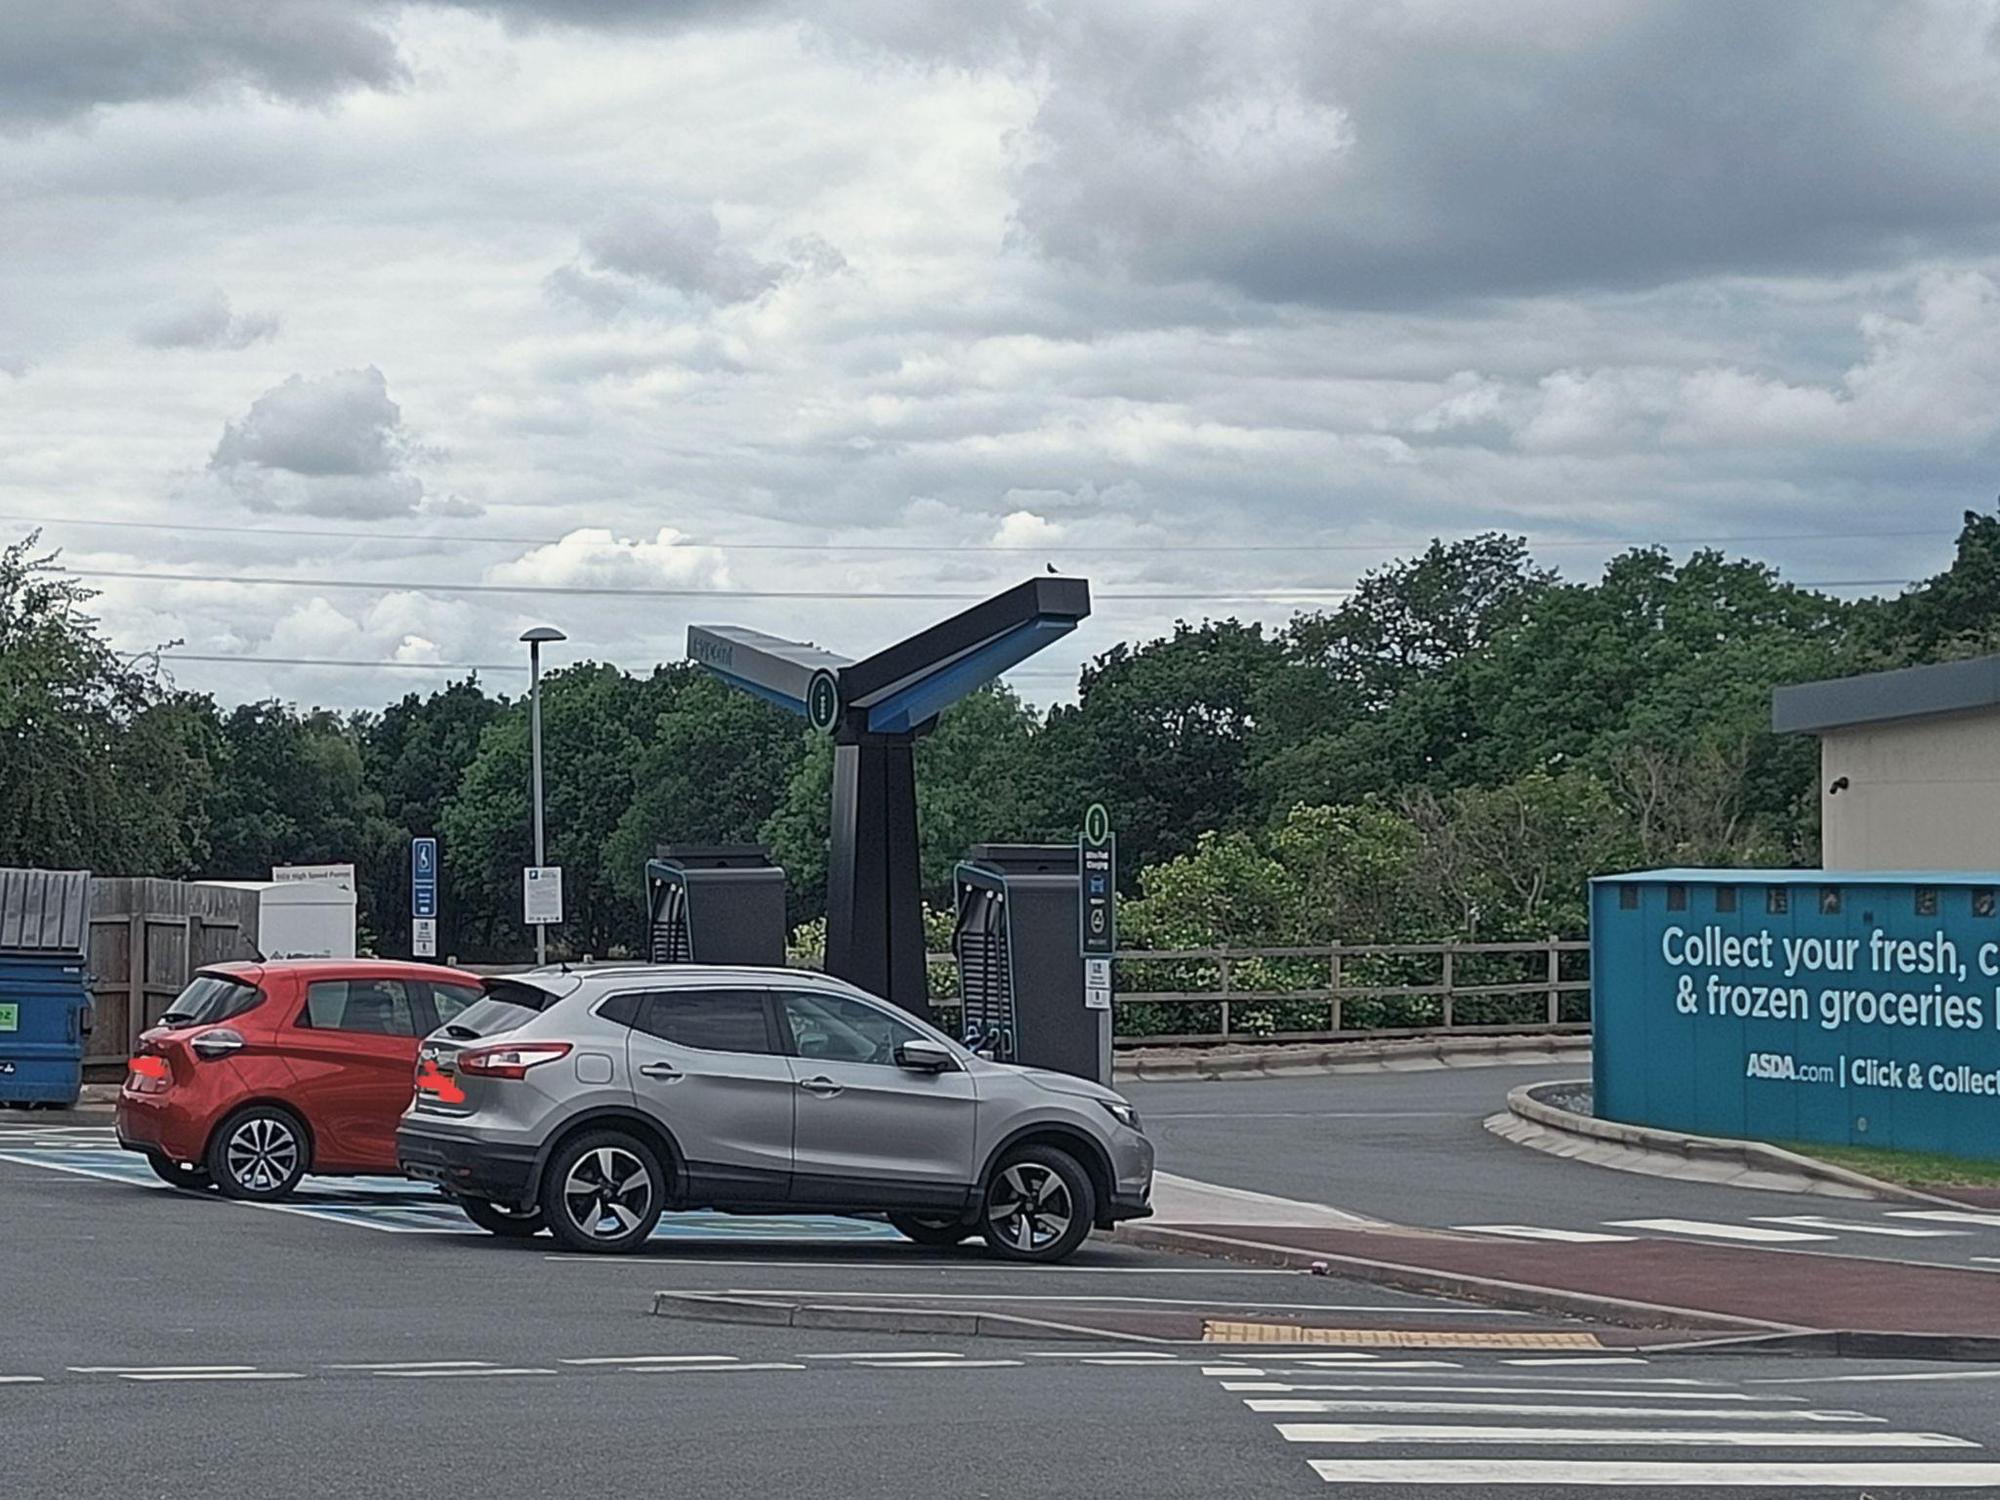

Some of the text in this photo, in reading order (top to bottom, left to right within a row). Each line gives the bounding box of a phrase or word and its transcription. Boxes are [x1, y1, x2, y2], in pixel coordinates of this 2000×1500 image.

[1662, 926, 1773, 968] Collect
[1782, 938, 1859, 977] your
[1869, 929, 1966, 982] fresh,
[1676, 975, 1698, 1013] &
[1706, 974, 1808, 1020] frozen
[1820, 984, 1983, 1029] groceries
[1746, 1053, 1834, 1082] ASDA.com
[1851, 1059, 1903, 1088] Click
[1907, 1063, 1924, 1089] &
